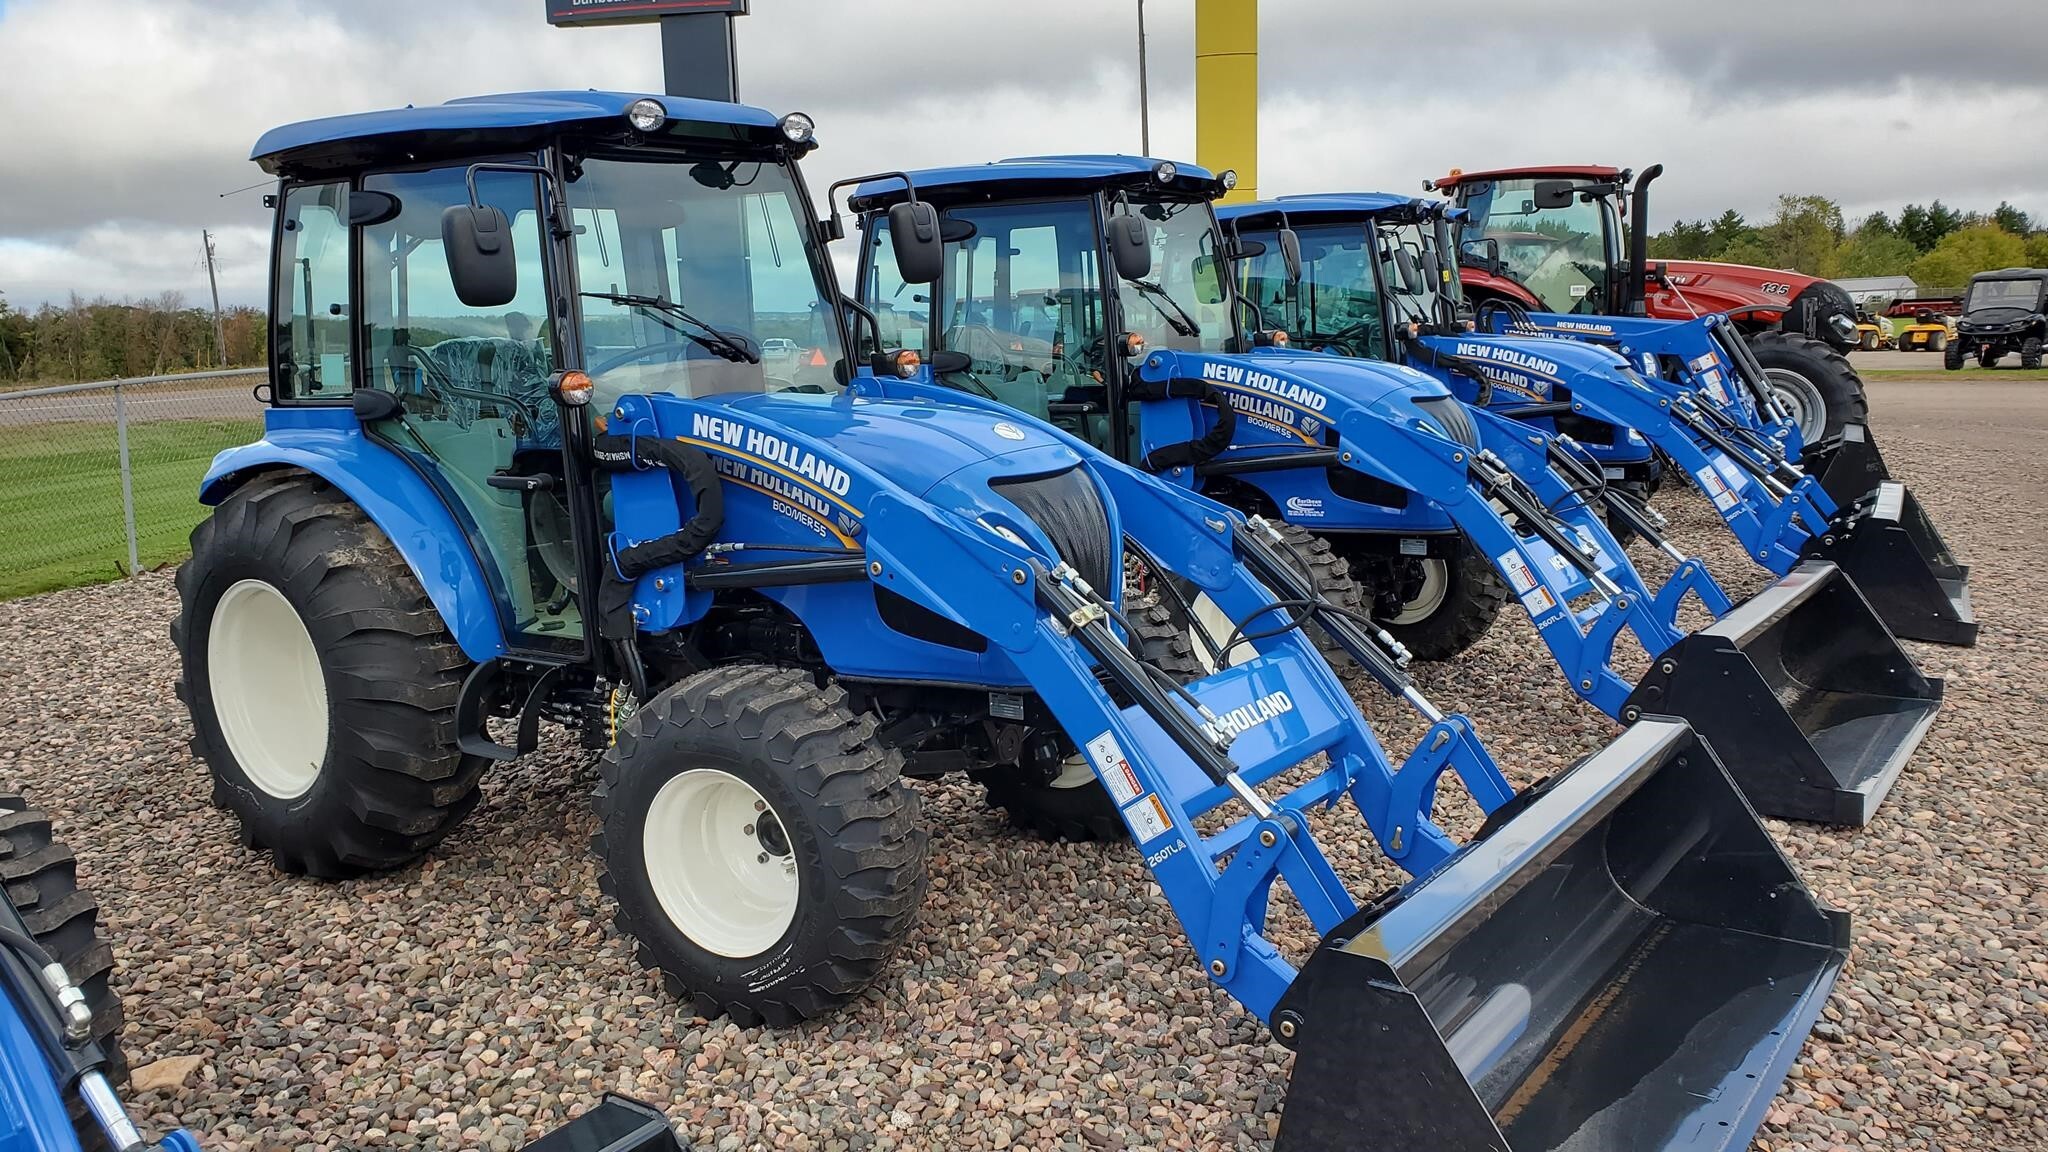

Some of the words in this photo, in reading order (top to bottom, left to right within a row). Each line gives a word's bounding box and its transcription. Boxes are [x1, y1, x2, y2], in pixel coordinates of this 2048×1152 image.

[1761, 282, 1790, 296] 135
[1556, 321, 1575, 329] NEW
[1575, 322, 1612, 332] HOLLAND
[1457, 342, 1491, 358] NEW
[1492, 347, 1558, 376] HOLLAND
[1203, 362, 1244, 383] NEW
[1245, 370, 1327, 411] HOLLAND
[1480, 366, 1528, 388] OLLAND
[1229, 391, 1295, 425] HOLLAND
[693, 413, 744, 447] NEW
[746, 428, 850, 497] HOLLAND
[713, 455, 747, 479] NEW
[750, 468, 830, 517] HOLLAND
[1224, 690, 1293, 738] HOLLAND
[1123, 767, 1141, 793] DANGER
[1147, 838, 1187, 868] 260TLA
